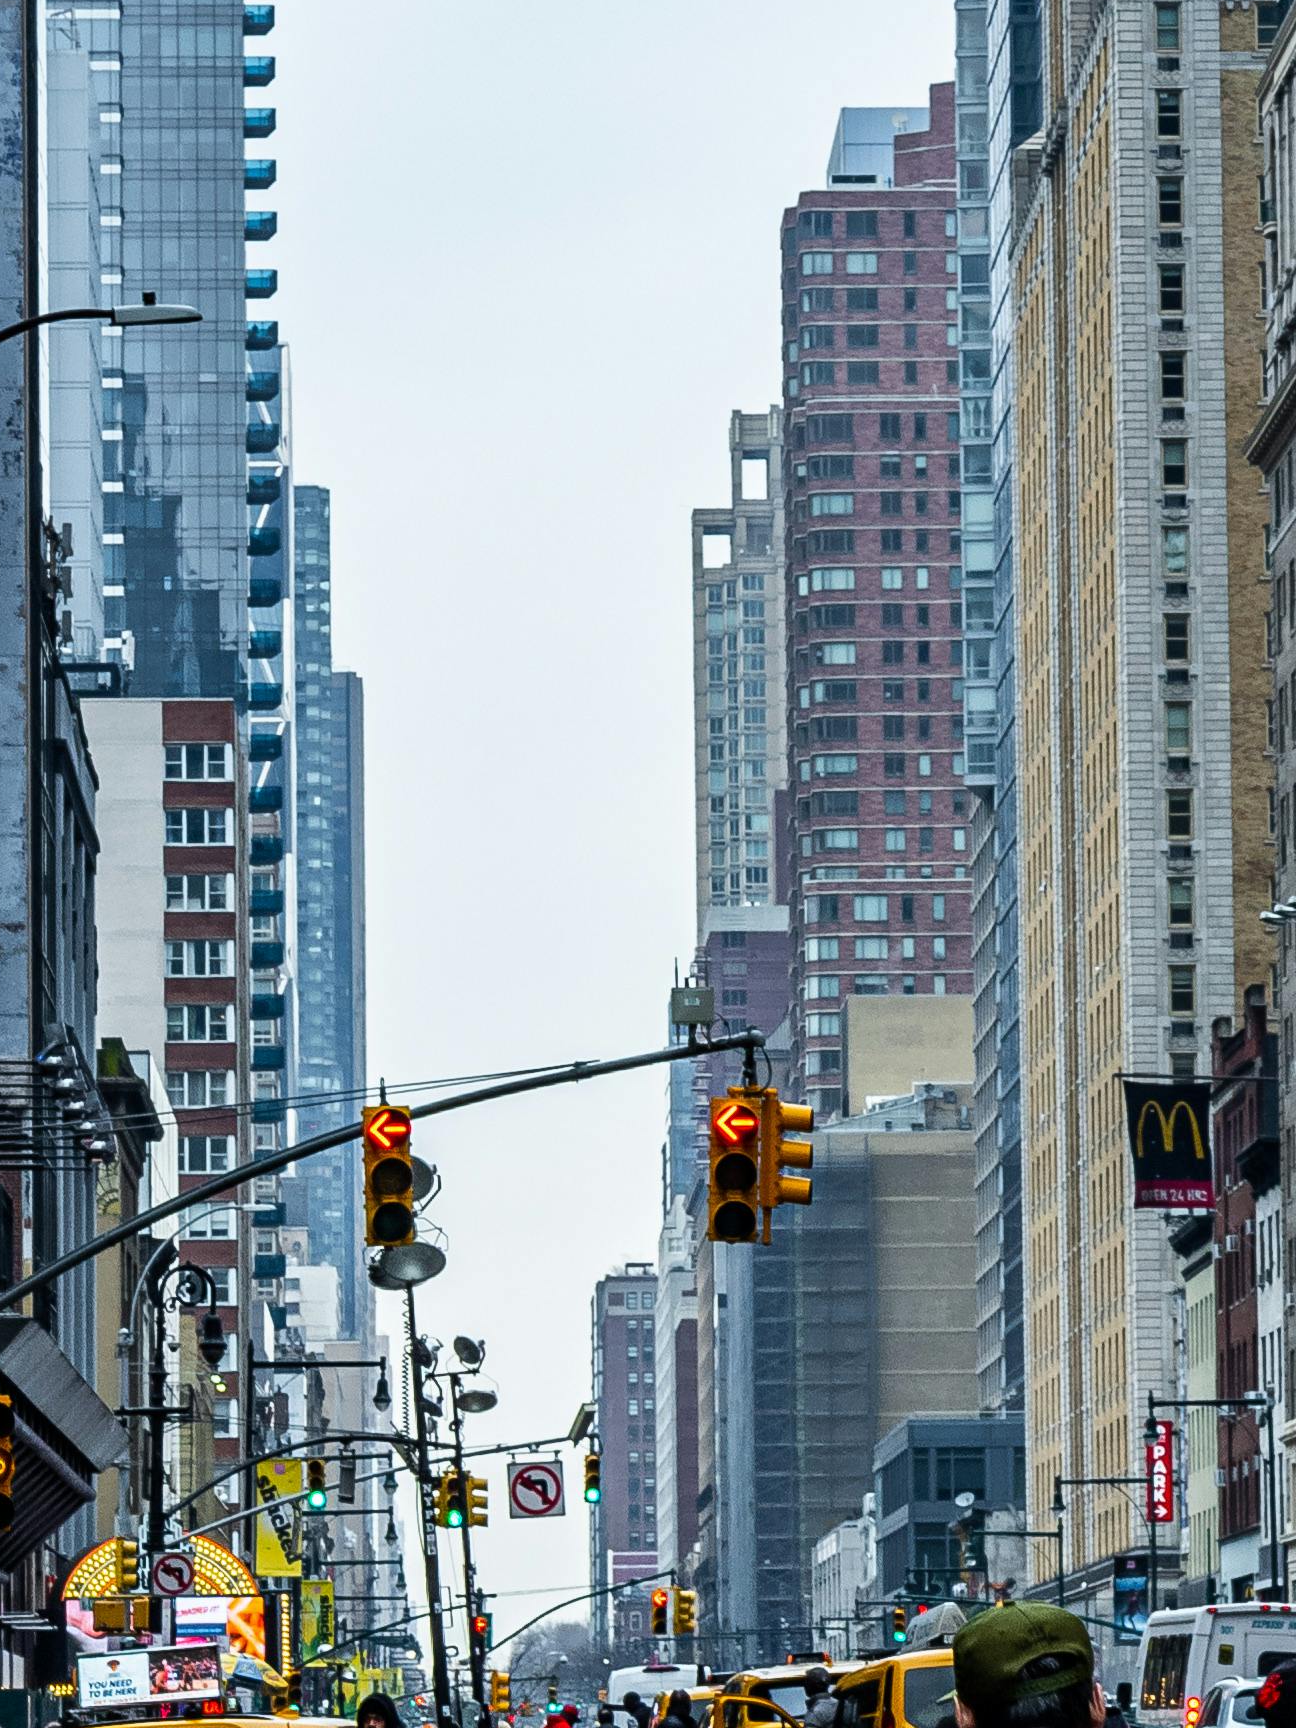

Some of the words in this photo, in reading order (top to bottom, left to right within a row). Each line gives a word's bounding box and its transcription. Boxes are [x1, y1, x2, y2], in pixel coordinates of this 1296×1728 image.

[1170, 1189, 1184, 1202] 24
[1153, 1445, 1167, 1503] PARK
[88, 1680, 108, 1690] YOU
[109, 1678, 133, 1688] NEED
[89, 1690, 101, 1698] TO
[102, 1688, 113, 1698] BE
[114, 1686, 137, 1696] HERE
